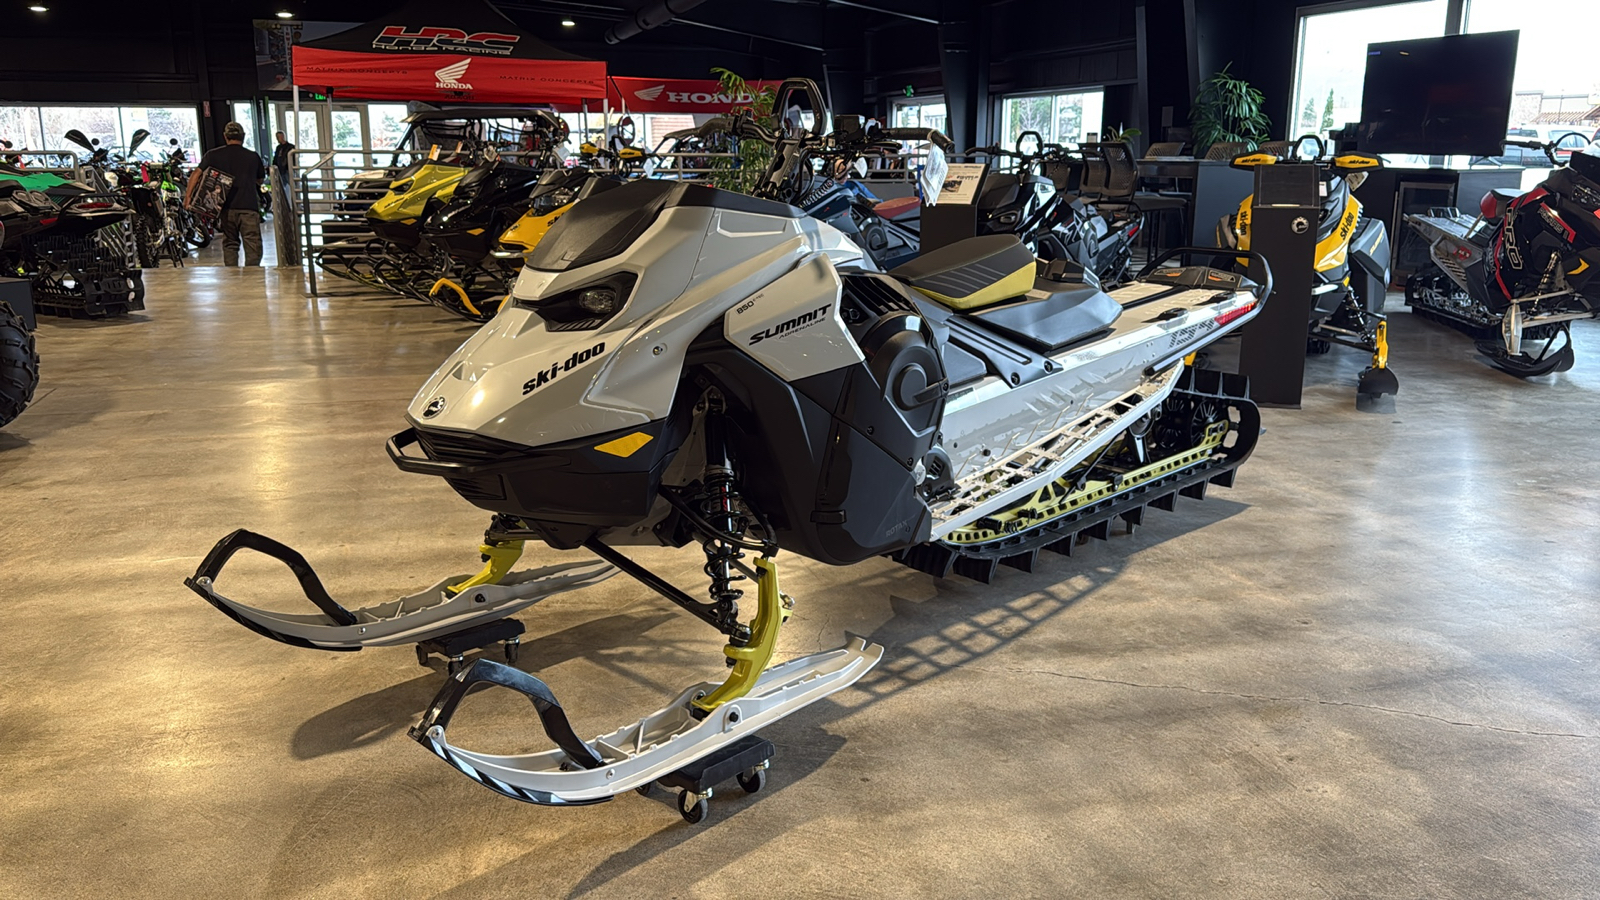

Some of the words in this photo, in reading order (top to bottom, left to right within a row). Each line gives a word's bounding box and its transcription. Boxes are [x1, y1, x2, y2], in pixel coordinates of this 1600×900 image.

[372, 25, 521, 52] HRC
[435, 82, 474, 90] HONDA
[539, 77, 595, 85] CONCEPTS
[666, 91, 768, 104] HOND
[1340, 212, 1355, 240] ski-doo
[1537, 206, 1565, 235] POLARIS
[1505, 208, 1523, 270] PRO
[736, 301, 755, 315] 850
[748, 303, 832, 346] SUMMIT
[778, 318, 826, 339] ADRENALINE
[521, 342, 606, 396] ski-doo
[885, 520, 909, 538] ROTAX
